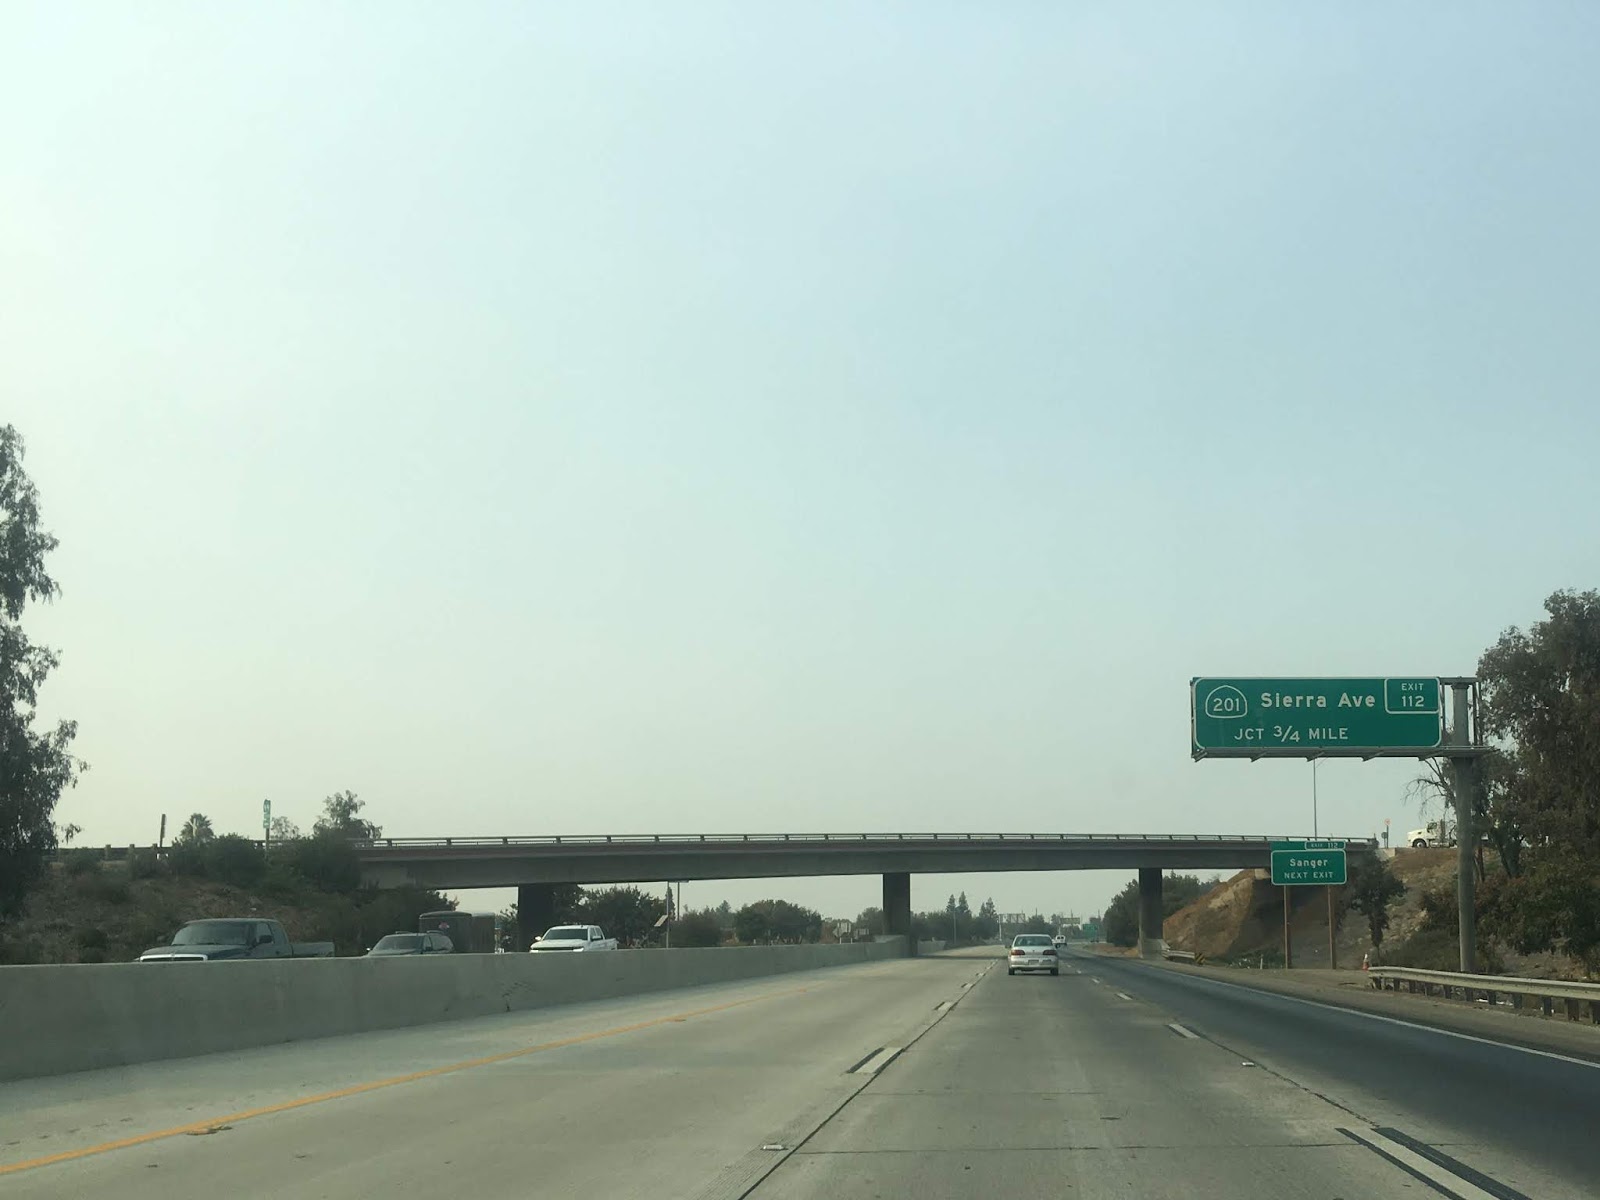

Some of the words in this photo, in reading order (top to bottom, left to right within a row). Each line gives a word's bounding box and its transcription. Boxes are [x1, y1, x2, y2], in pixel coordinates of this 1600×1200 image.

[1401, 683, 1424, 691] EXIT
[1213, 698, 1240, 712] 201
[1260, 692, 1327, 708] Sierra
[1337, 692, 1376, 708] Ave
[1401, 695, 1425, 707] 112
[1234, 728, 1265, 740] JCT
[1273, 725, 1301, 743] 3/4
[1308, 728, 1349, 740] MILE
[1289, 858, 1328, 869] Sanger
[1283, 871, 1308, 879] NEXT
[1313, 871, 1334, 879] EXIT
